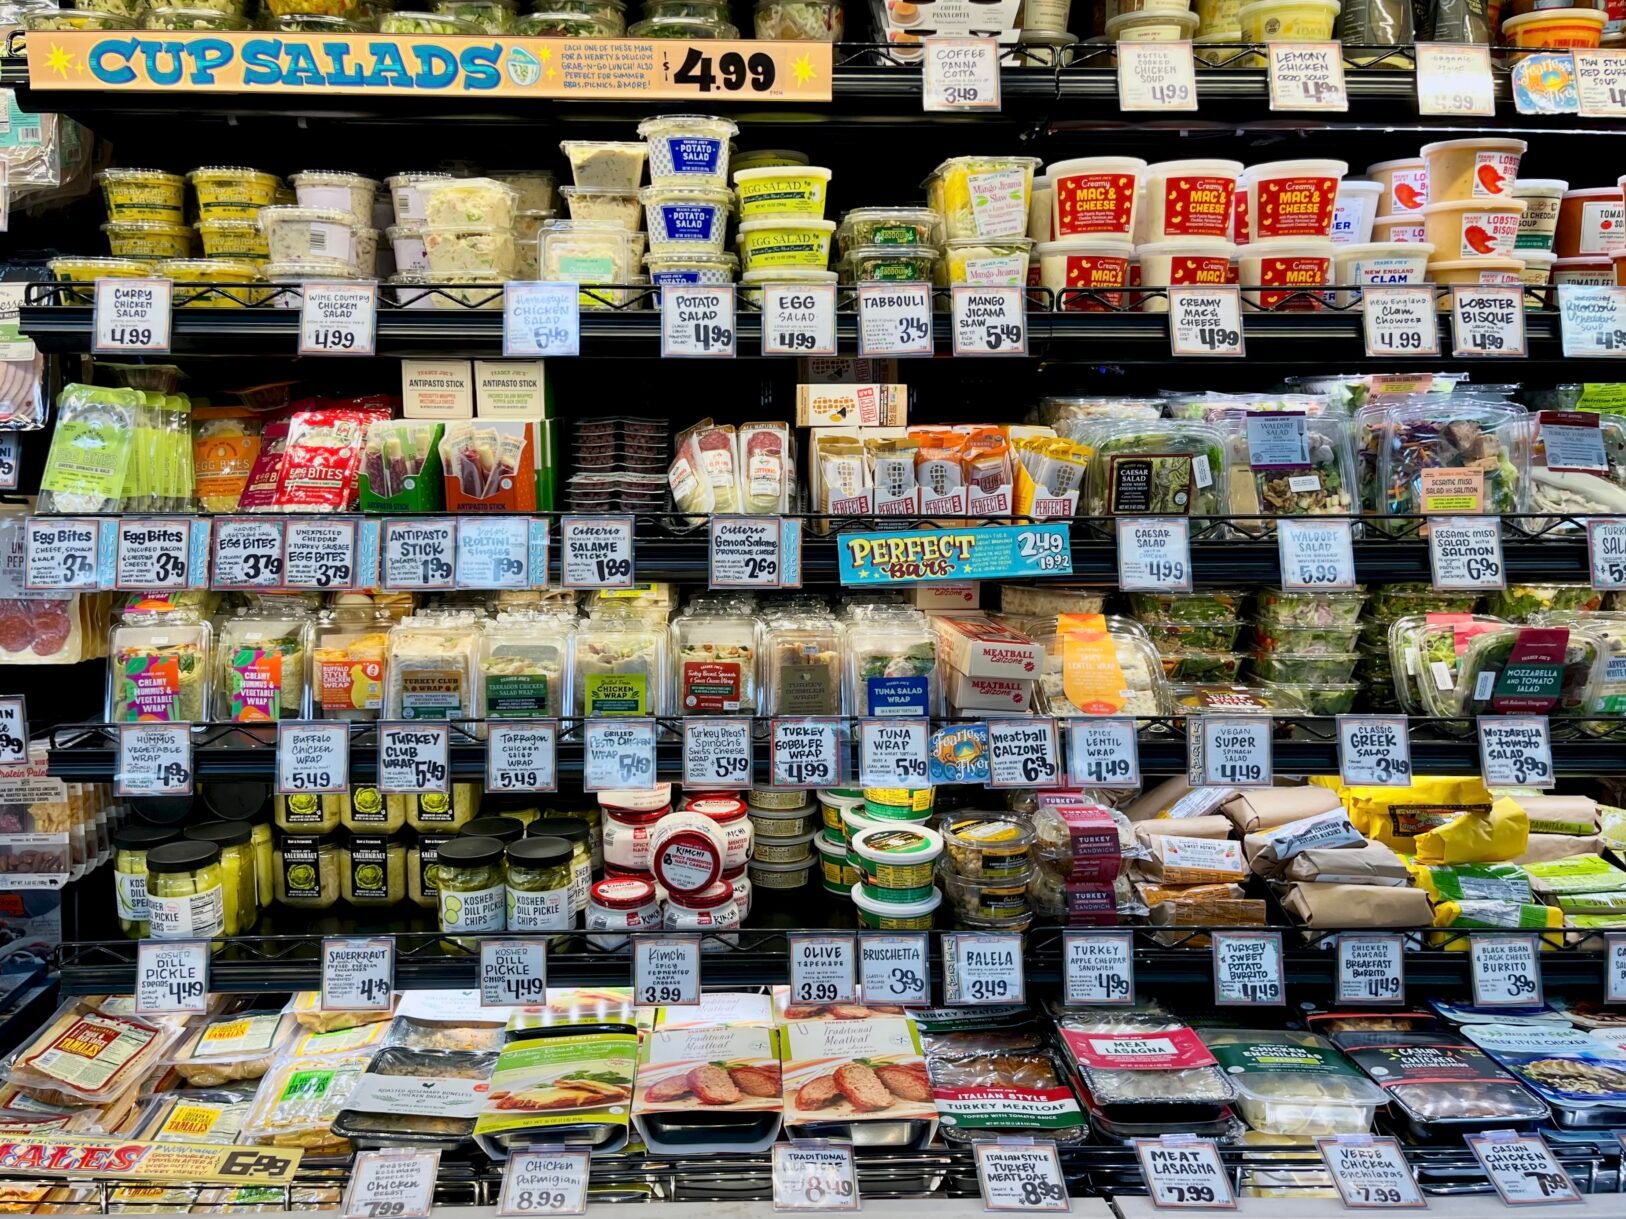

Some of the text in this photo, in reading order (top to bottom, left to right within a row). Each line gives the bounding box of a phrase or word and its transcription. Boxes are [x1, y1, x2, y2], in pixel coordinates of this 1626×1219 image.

[936, 49, 986, 59] COFFEE
[1276, 52, 1327, 62] LEMONY
[88, 36, 503, 90] CUP SALADS
[608, 62, 635, 70] LUNCH!
[941, 61, 977, 70] PANNA
[1279, 63, 1328, 72] CHICKEN
[944, 69, 974, 78] COTTA
[1135, 66, 1176, 74] CHICKEN
[1593, 78, 1617, 86] SOUP
[681, 144, 711, 153] POTATO
[683, 152, 709, 160] SALAD
[973, 180, 1021, 194] Mango Jicama
[1286, 182, 1315, 192] Creamy
[991, 194, 1007, 202] Slaw
[1190, 191, 1226, 202] MAC &
[1189, 203, 1225, 213] CHEESE
[1279, 204, 1319, 213] CHEESE
[673, 212, 705, 220] POTATO
[1371, 275, 1407, 283] CLAM
[114, 289, 151, 300] CURRY
[309, 294, 370, 303] WINE COUNTRY
[318, 302, 357, 311] CHICKEN
[676, 296, 719, 308] POTATO
[779, 296, 815, 309] EGG
[863, 296, 924, 308] TABBOULI
[968, 297, 1005, 306] MANGO
[1180, 299, 1221, 308] CREAMY
[1459, 298, 1516, 309] LOBSTER
[116, 309, 147, 318] SALAD
[323, 310, 352, 318] SALAD
[965, 308, 1005, 318] JICAMA
[1462, 312, 1514, 324] BISQUE
[960, 319, 986, 327] SLAW
[1181, 319, 1220, 327] CHEESE
[410, 379, 464, 388] ANTIPASTO STICK
[483, 379, 537, 388] ANTIPASTO STICK
[1260, 422, 1293, 430] WALDORF
[308, 468, 343, 479] BITES
[926, 495, 962, 515] PERFECT BAR
[33, 530, 92, 544] Egg Bites
[390, 530, 448, 541] ANTIPASTO
[1135, 529, 1171, 538] CAESAR
[1290, 531, 1338, 542] WALDORF
[220, 538, 276, 550] EGG BITES
[570, 542, 617, 552] SALAME
[715, 536, 777, 548] Genoa Salame
[1137, 539, 1166, 547] SALAD
[401, 542, 444, 557] STICK
[847, 535, 976, 568] PERFECT
[1442, 548, 1494, 556] SALMON
[882, 559, 955, 579] Bars
[983, 648, 1034, 658] MEATBALL
[990, 656, 1023, 665] Calzone
[1507, 669, 1557, 677] MOZZARELLA
[135, 695, 173, 704] VEGETABLE
[247, 697, 267, 705] WRAP
[878, 729, 910, 740] TUNA
[1358, 726, 1392, 734] CLASSIC
[1484, 729, 1541, 738] MOZZARELLA
[137, 736, 175, 745] HUMMUS
[386, 732, 440, 745] TURKEY
[1086, 738, 1122, 746] LENTIL
[1351, 734, 1396, 748] GREEK
[775, 740, 823, 750] GOBBLER
[873, 740, 910, 750] WRAP
[386, 746, 418, 757] CLUB
[993, 744, 1047, 757] CALZONE
[1489, 750, 1523, 760] SALAD
[676, 846, 705, 857] KIMCHI
[686, 857, 712, 866] FERMENTED
[464, 894, 494, 906] KOSHER
[155, 912, 179, 922] PICKLE
[465, 915, 487, 925] CHIPS
[517, 916, 538, 926] CHIPS
[804, 946, 842, 958] OLIVE
[1226, 943, 1266, 952] TURKEY
[329, 950, 388, 964] SAUERKRAUT
[863, 948, 920, 961] BRUSCHETTA
[967, 951, 1013, 966] BALELA
[1230, 953, 1263, 962] SWEET
[157, 959, 186, 968] DILL
[1346, 960, 1392, 968] BREAKFAST
[1483, 963, 1526, 972] BURRITO
[485, 964, 530, 976] PICKLE
[824, 1025, 872, 1036] Traditional
[1243, 1051, 1322, 1059] ENCHILADAS
[1002, 1103, 1066, 1111] MEATLOAF
[168, 1121, 208, 1132] TAMALES
[986, 1154, 1020, 1162] ITALIAN
[1150, 1151, 1200, 1162] MEAT
[1485, 1153, 1546, 1163] CHICKEN
[991, 1163, 1035, 1173] TURKEY
[1154, 1163, 1216, 1174] LASAGNA
[1491, 1163, 1547, 1172] ALFREDO
